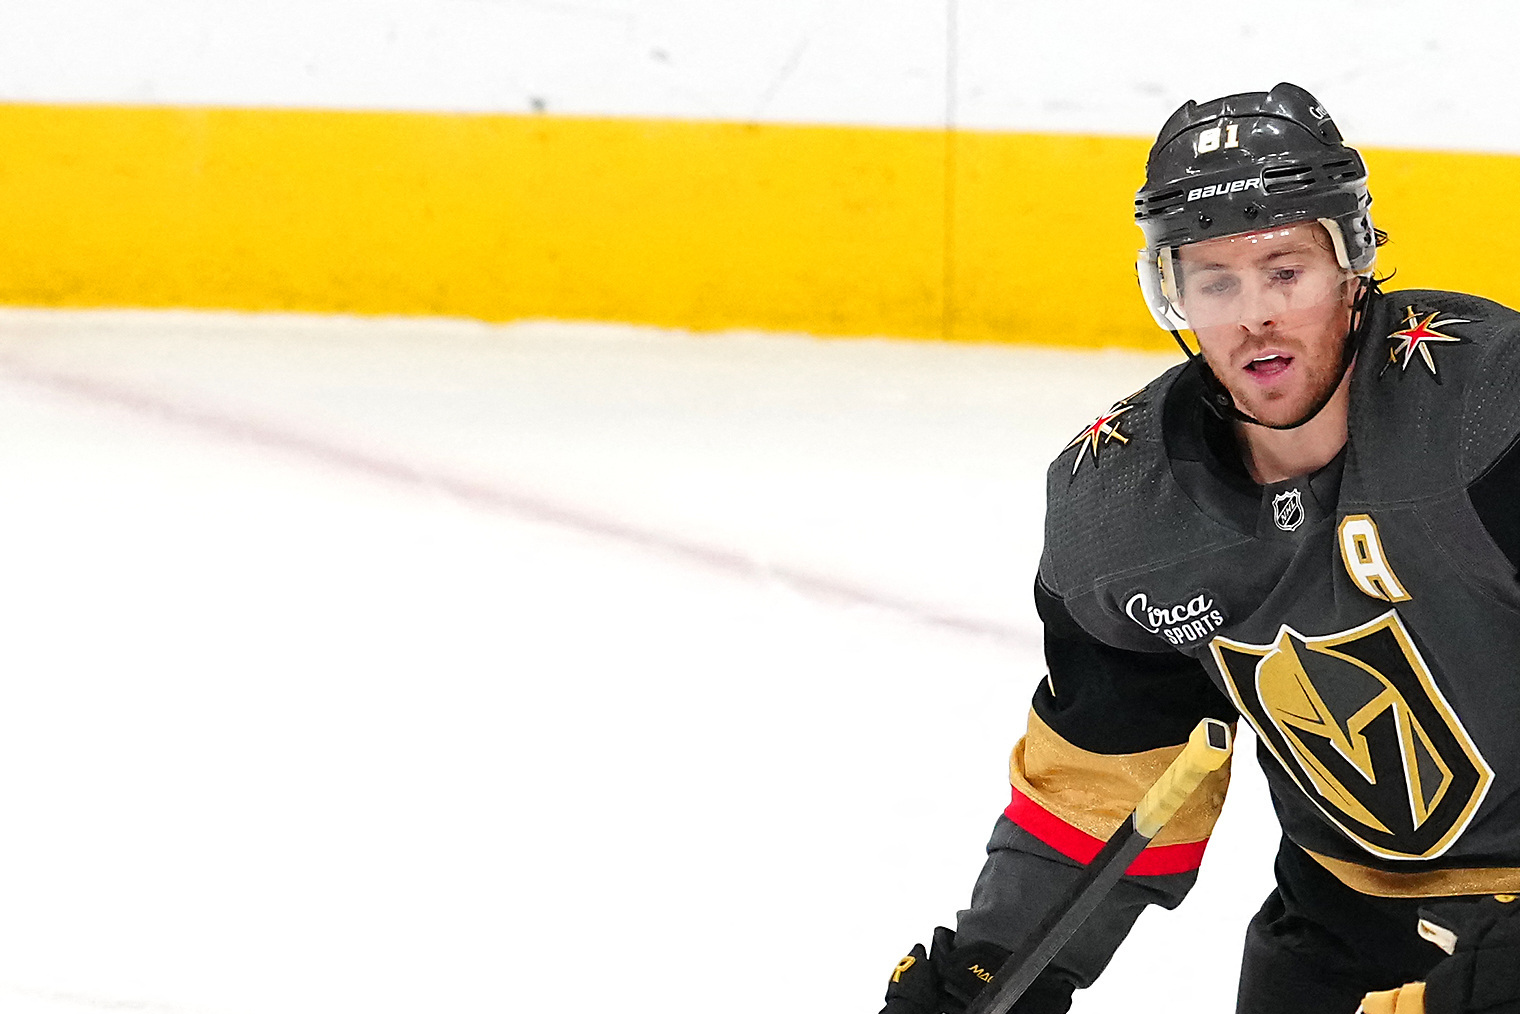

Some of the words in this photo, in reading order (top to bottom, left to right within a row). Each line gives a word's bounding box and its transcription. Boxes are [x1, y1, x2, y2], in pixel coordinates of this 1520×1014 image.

[1198, 124, 1240, 153] 81
[1187, 177, 1261, 202] BAUER
[1337, 513, 1413, 603] A
[1125, 593, 1214, 634] Circa
[1163, 608, 1225, 646] SPORTS
